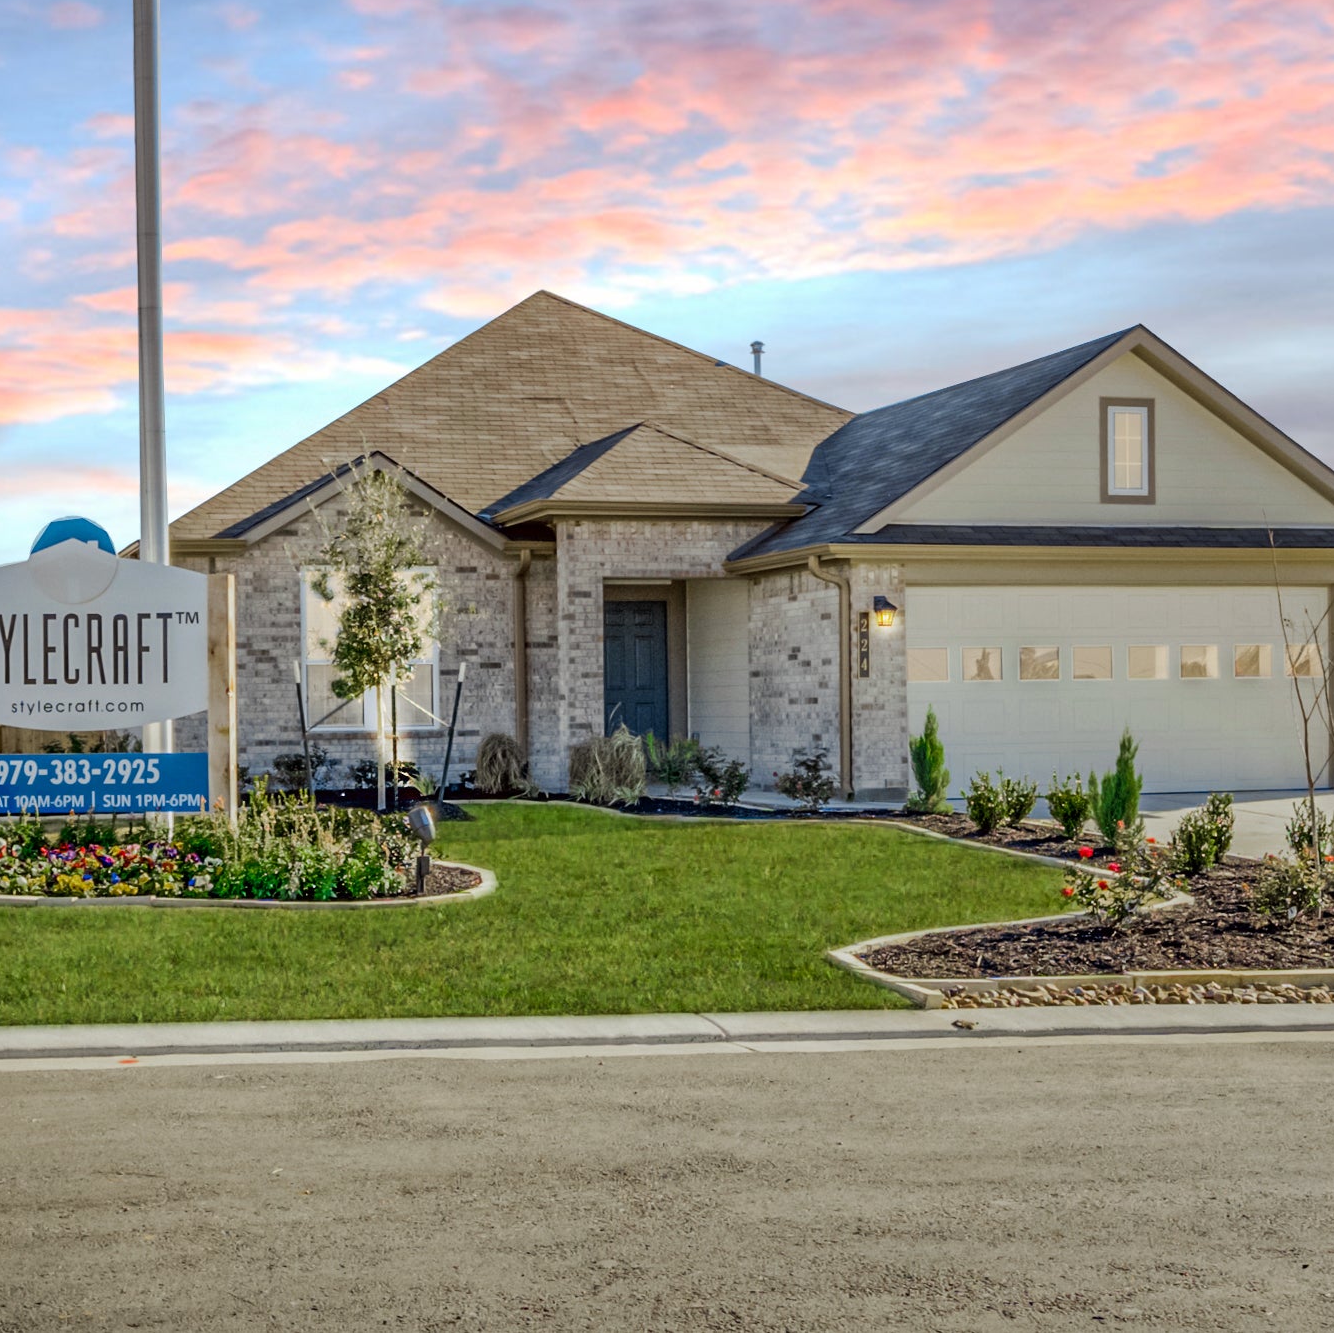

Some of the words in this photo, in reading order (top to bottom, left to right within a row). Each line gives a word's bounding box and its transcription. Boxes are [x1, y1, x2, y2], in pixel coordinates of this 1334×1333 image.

[860, 618, 868, 671] 224
[11, 700, 145, 715] stylecraft.com
[13, 794, 85, 808] 10AM-6PM
[102, 794, 131, 808] SUN
[135, 793, 201, 807] 1PM-6PM
